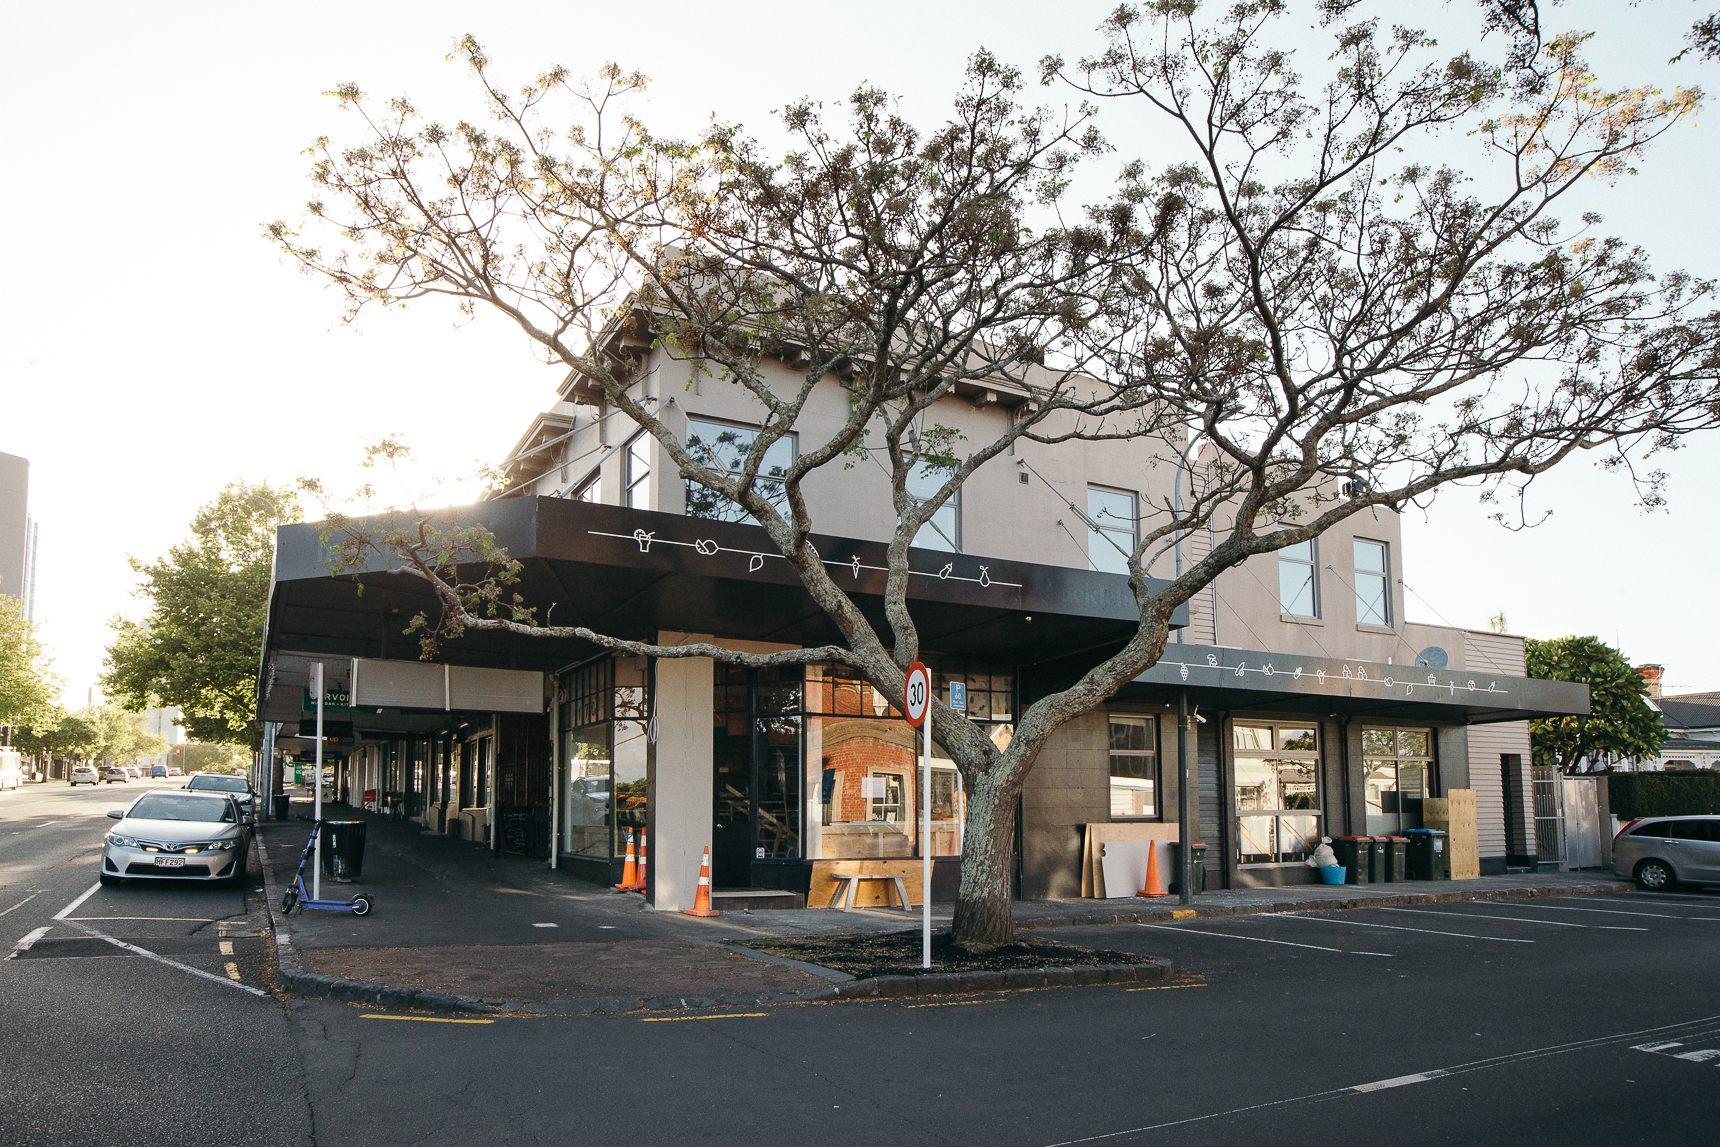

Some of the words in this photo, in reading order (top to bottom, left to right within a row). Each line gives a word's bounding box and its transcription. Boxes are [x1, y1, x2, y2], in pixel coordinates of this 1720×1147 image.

[956, 684, 961, 692] P
[910, 681, 924, 707] 30
[955, 692, 962, 700] 60
[156, 858, 184, 866] HFF292
